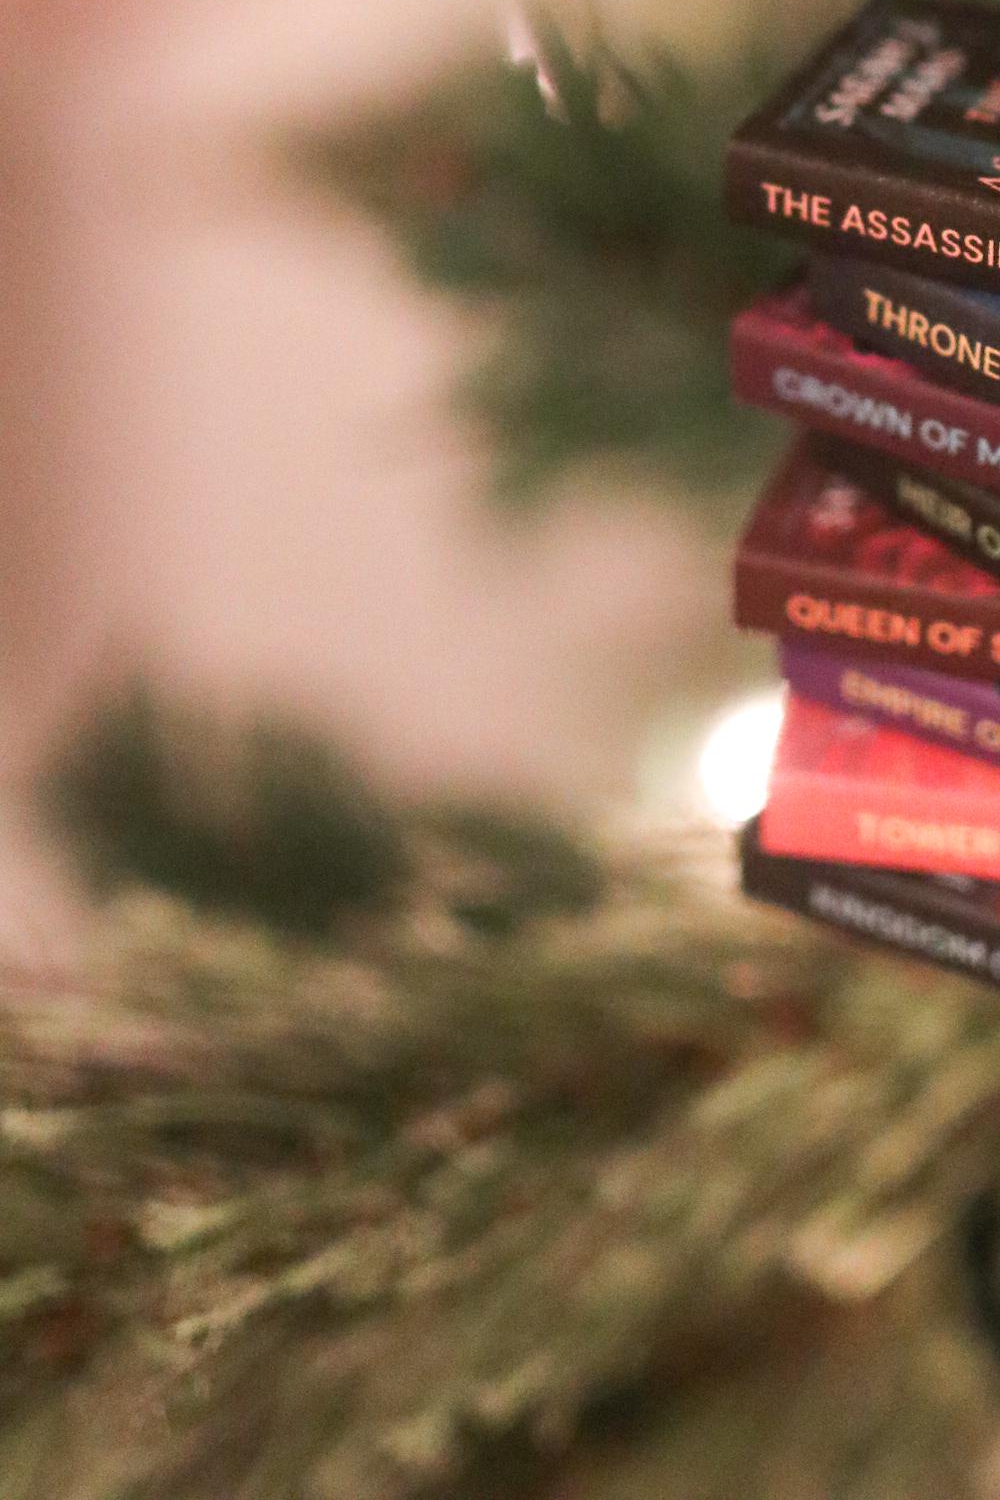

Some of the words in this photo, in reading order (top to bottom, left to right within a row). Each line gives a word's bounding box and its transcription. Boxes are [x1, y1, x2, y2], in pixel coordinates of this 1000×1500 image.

[760, 182, 831, 228] THE
[773, 368, 912, 438] CROWN
[919, 418, 968, 456] OF
[787, 595, 921, 646] QUEEN
[927, 621, 984, 657] OF
[857, 812, 1000, 859] TOWER
